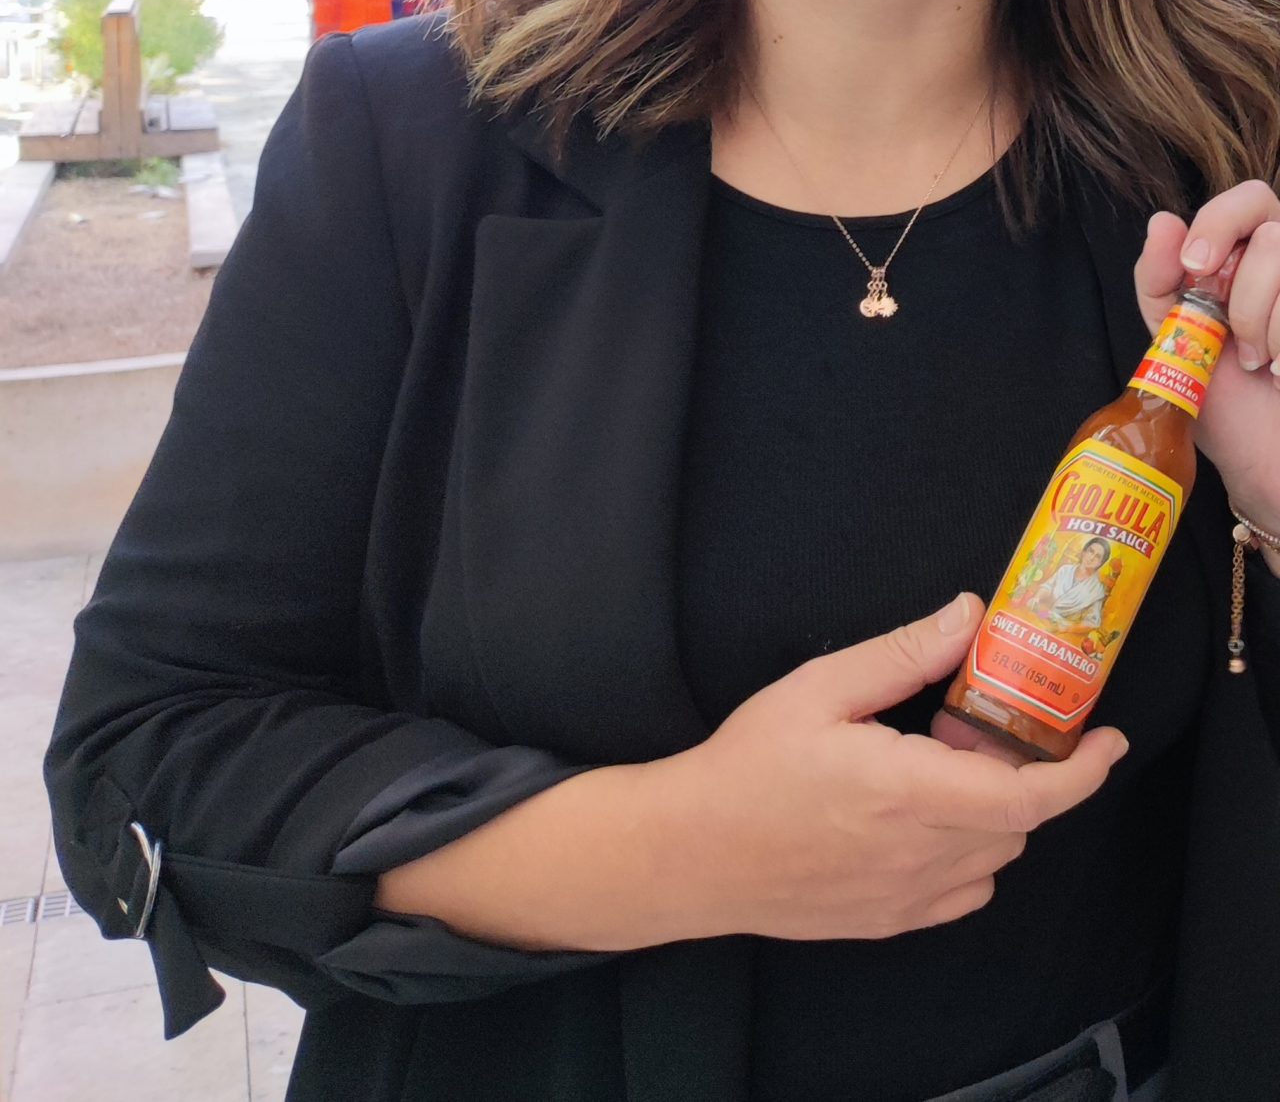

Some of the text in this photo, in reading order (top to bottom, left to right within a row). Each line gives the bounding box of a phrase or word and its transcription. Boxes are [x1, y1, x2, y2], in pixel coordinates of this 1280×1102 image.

[1146, 371, 1199, 402] HABANERO
[1160, 365, 1195, 387] SWEET
[1051, 471, 1166, 543] CHOLULA
[1118, 477, 1139, 491] FROM
[1140, 488, 1165, 507] MEXICO
[1066, 518, 1149, 553] HOT SAUCE
[992, 614, 1096, 675] SWEET HABANERO
[992, 651, 1000, 663] 5
[1001, 654, 1010, 668] FL
[1011, 661, 1026, 675] OZ
[1025, 667, 1048, 687] (150
